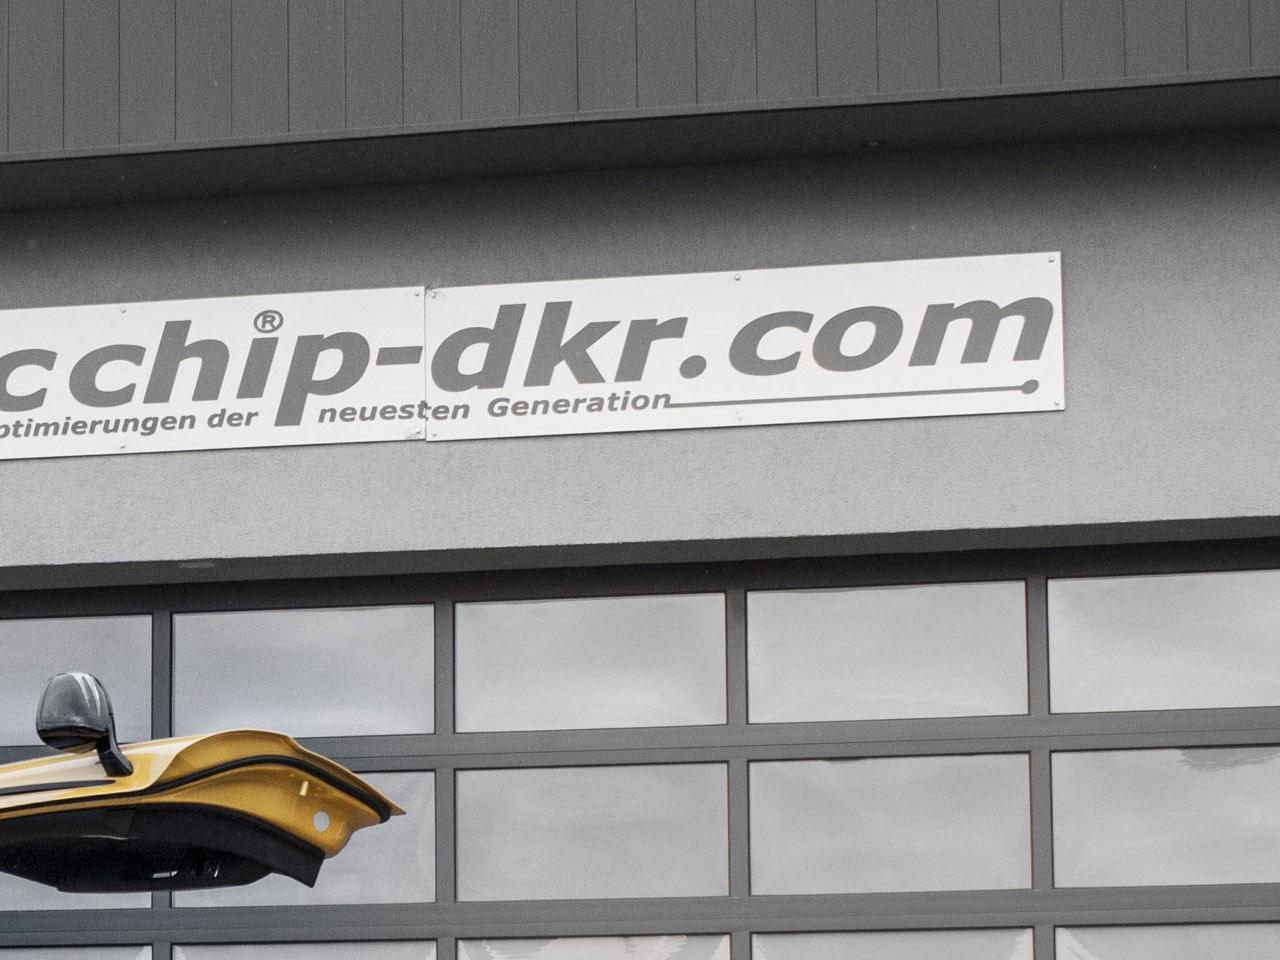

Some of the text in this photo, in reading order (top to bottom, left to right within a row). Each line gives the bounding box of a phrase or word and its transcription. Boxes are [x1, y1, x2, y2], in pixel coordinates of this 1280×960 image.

[206, 408, 259, 430] der
[318, 399, 470, 424] neuesten
[487, 389, 671, 419] Generation
